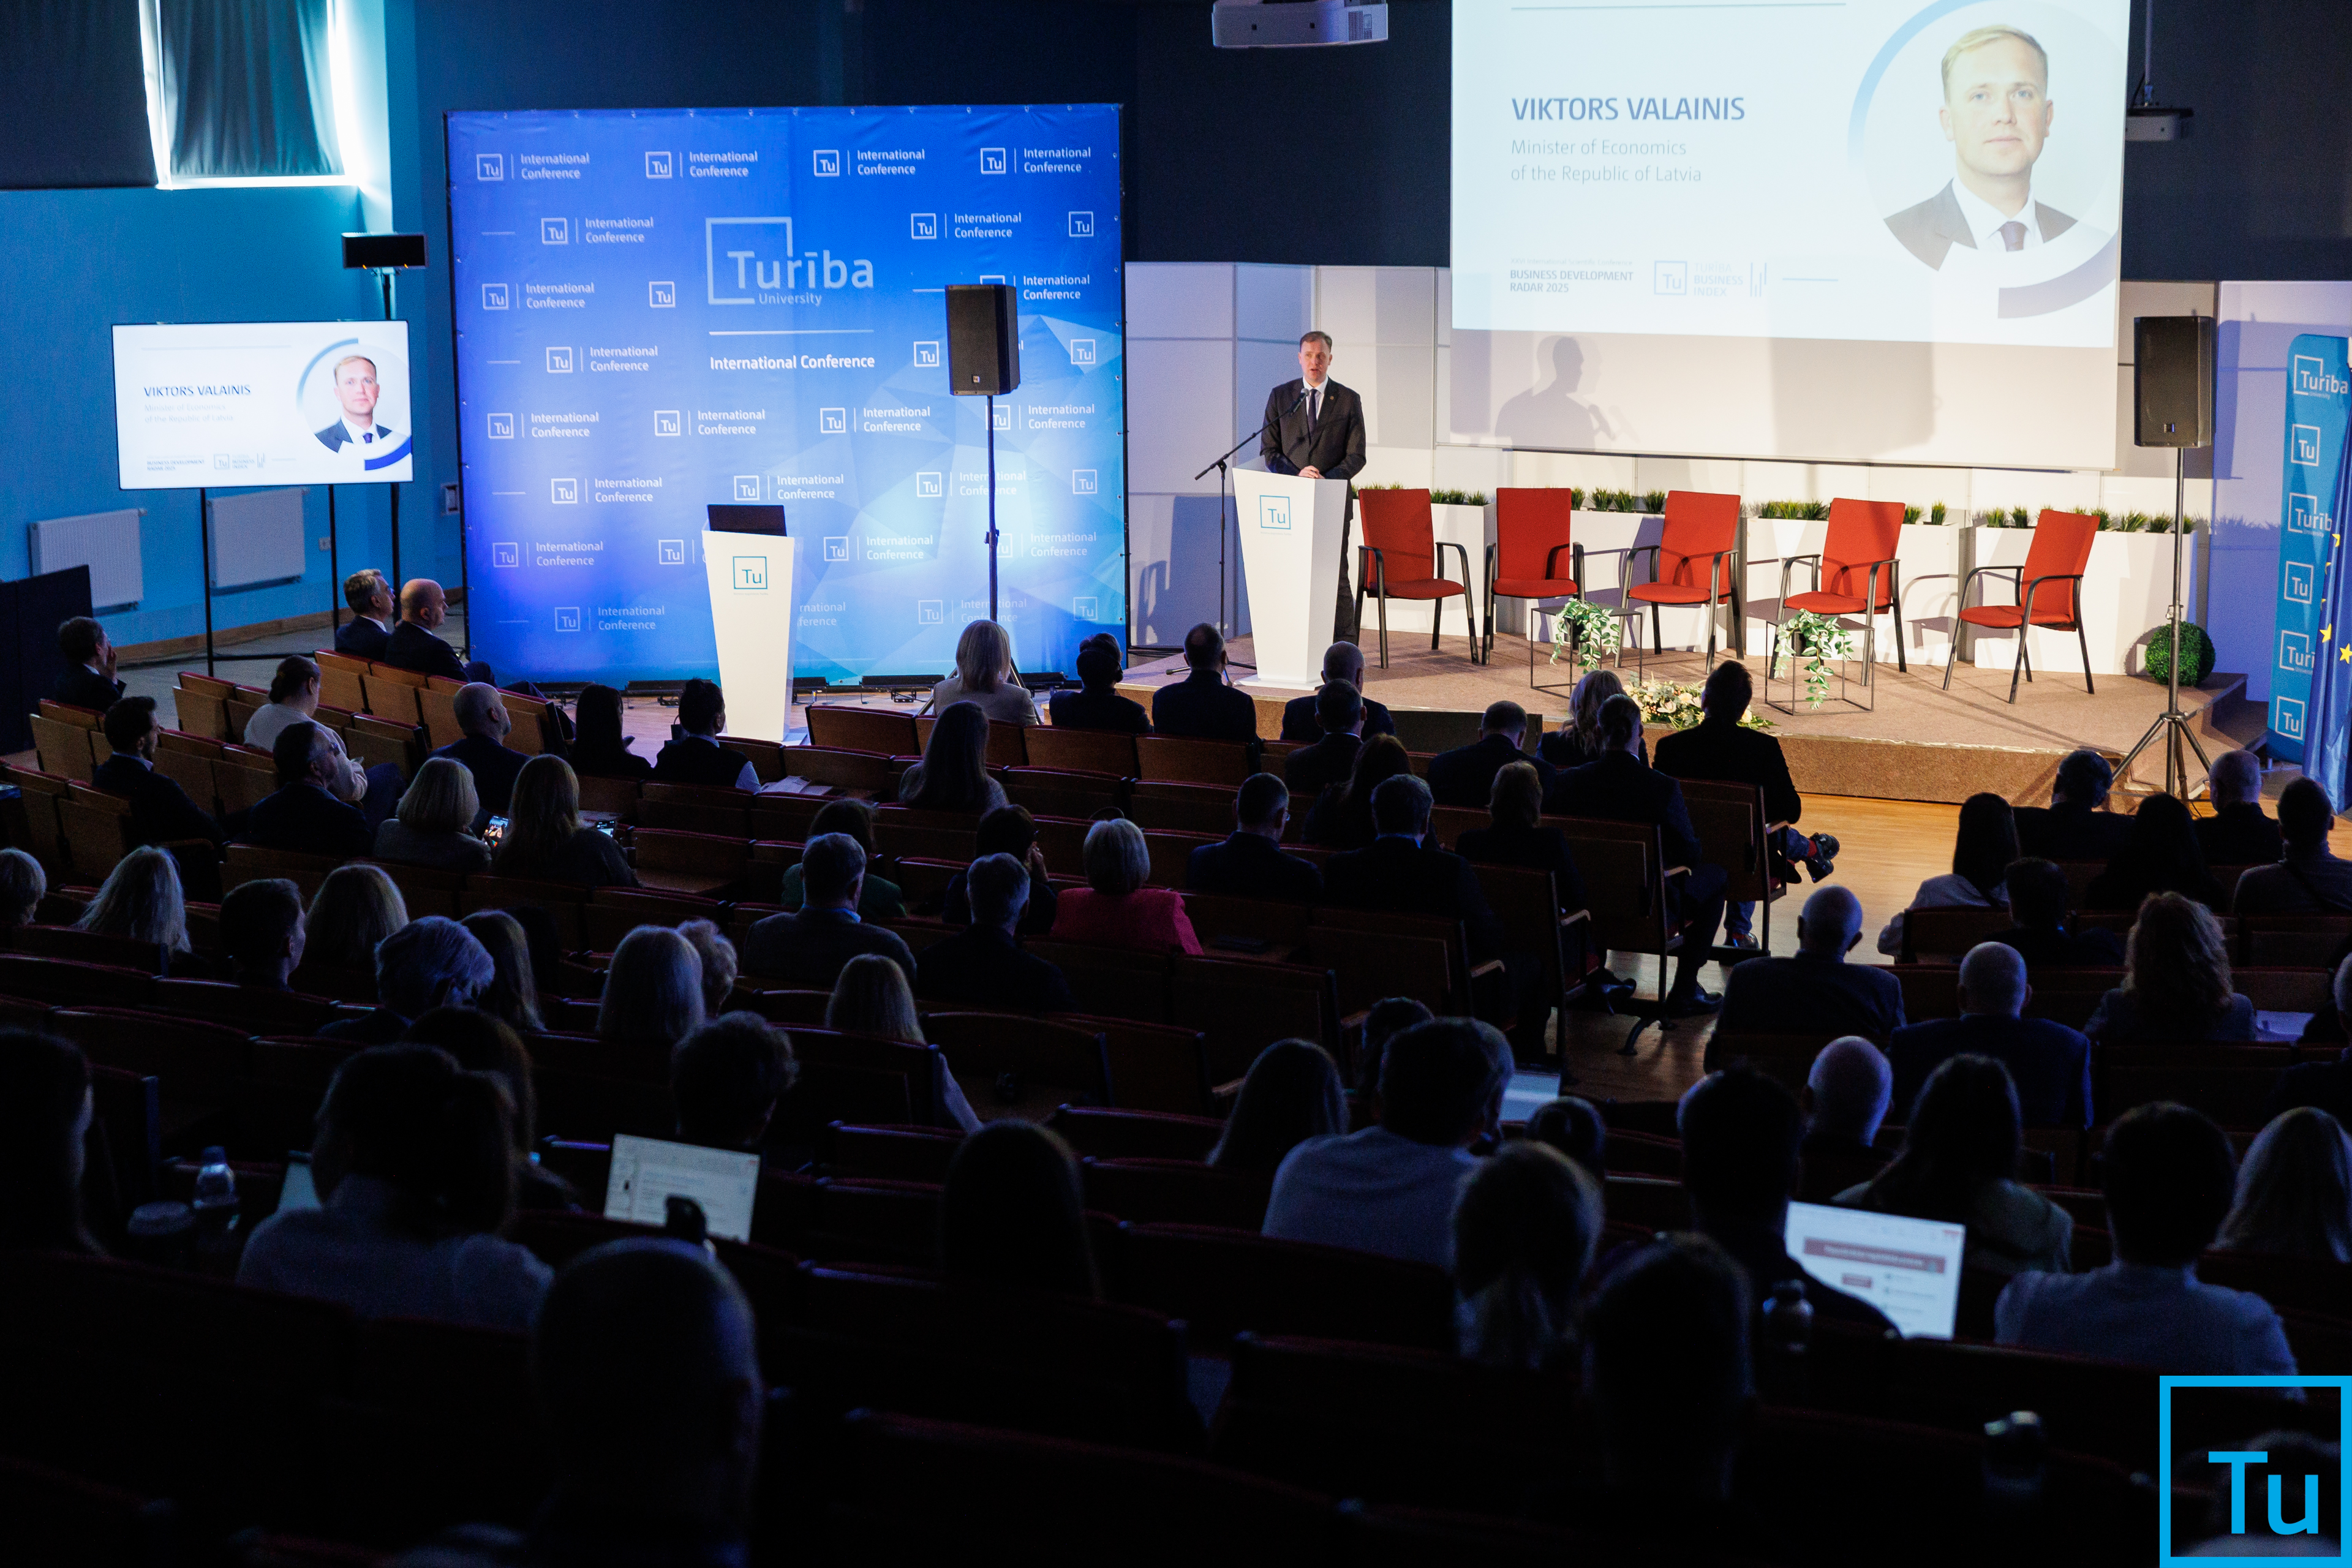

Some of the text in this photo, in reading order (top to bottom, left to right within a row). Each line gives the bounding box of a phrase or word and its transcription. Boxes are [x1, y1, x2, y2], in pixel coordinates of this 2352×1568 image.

[1512, 97, 1745, 120] VIKTORS VALAINIS
[1512, 138, 1687, 154] Minister of Economics
[521, 153, 590, 165] International
[690, 151, 758, 163] International
[858, 148, 925, 160] International
[1024, 147, 1091, 159] International
[484, 163, 499, 176] Tu
[653, 161, 668, 175] Tu
[820, 159, 835, 172] Tu
[858, 163, 916, 175] Conference
[987, 157, 1002, 170] Tu
[1024, 161, 1082, 173] Conference
[521, 168, 581, 179] Conference
[690, 165, 749, 178] Conference
[1511, 165, 1701, 184] of the Republic of Latvia
[586, 217, 654, 229] International
[955, 213, 1021, 224] International
[918, 222, 933, 235] Tu
[955, 227, 1012, 238] Conference
[1076, 221, 1090, 233] Tu
[548, 227, 564, 240] Tu
[586, 232, 645, 243] Conference
[727, 249, 874, 290] Turība
[1510, 270, 1634, 281] BUSINESS DEVELOPMENT
[1023, 274, 1090, 286] International
[1662, 274, 1681, 289] Tu
[1694, 275, 1743, 285] BUSINESS
[526, 282, 595, 295] International
[1510, 282, 1569, 293] RADAR 2025
[1694, 287, 1727, 296] INDEX
[489, 293, 504, 305] Tu
[656, 290, 671, 303] Tu
[759, 292, 822, 306] University
[1023, 288, 1080, 300] Conference
[526, 297, 586, 309] Conference
[590, 345, 658, 358] International
[920, 350, 935, 363] Tu
[1077, 349, 1091, 361] Tu
[553, 356, 568, 369] Tu
[590, 360, 649, 372] Conference
[710, 354, 875, 370] International Conference
[2301, 371, 2348, 394] Turība
[144, 384, 251, 397] VIKTORS VALAINIS
[698, 409, 765, 421] International
[864, 406, 930, 418] International
[1028, 404, 1095, 415] International
[531, 412, 599, 423] International
[827, 417, 842, 429] Tu
[1028, 418, 1085, 429] Conference
[494, 422, 509, 435] Tu
[531, 426, 590, 437] Conference
[661, 420, 676, 432] Tu
[698, 424, 756, 435] Conference
[864, 421, 921, 432] Conference
[2299, 439, 2314, 459] Tu
[777, 473, 844, 486] International
[960, 470, 1026, 481] Interntional
[595, 477, 662, 489] International
[923, 480, 938, 493] Tu
[1079, 478, 1094, 491] Tu
[558, 487, 573, 500] Tu
[741, 484, 755, 497] Tu
[777, 487, 835, 499] Conference
[960, 485, 1017, 496] Confeence
[595, 491, 653, 503] Conference
[1268, 508, 1286, 524] Tu
[2294, 508, 2332, 531] Turīb
[867, 535, 933, 547] International
[1030, 532, 1096, 543] International
[536, 541, 603, 552] International
[830, 546, 845, 557] Tu
[1030, 546, 1087, 557] Conference
[499, 552, 514, 564] Tu
[665, 549, 680, 561] Tu
[867, 549, 924, 560] Conference
[536, 555, 595, 567] Conference
[742, 569, 761, 584] Tu
[2292, 577, 2308, 597] Tu
[799, 601, 845, 612] rnational
[961, 598, 1027, 609] Interntional
[598, 606, 665, 617] International
[925, 608, 939, 620] Tu
[1080, 606, 1094, 618] Tu
[561, 616, 576, 628] Tu
[598, 620, 656, 630] Conference
[799, 616, 837, 626] ference
[2287, 646, 2315, 668] Turī
[2283, 712, 2299, 733] Tu
